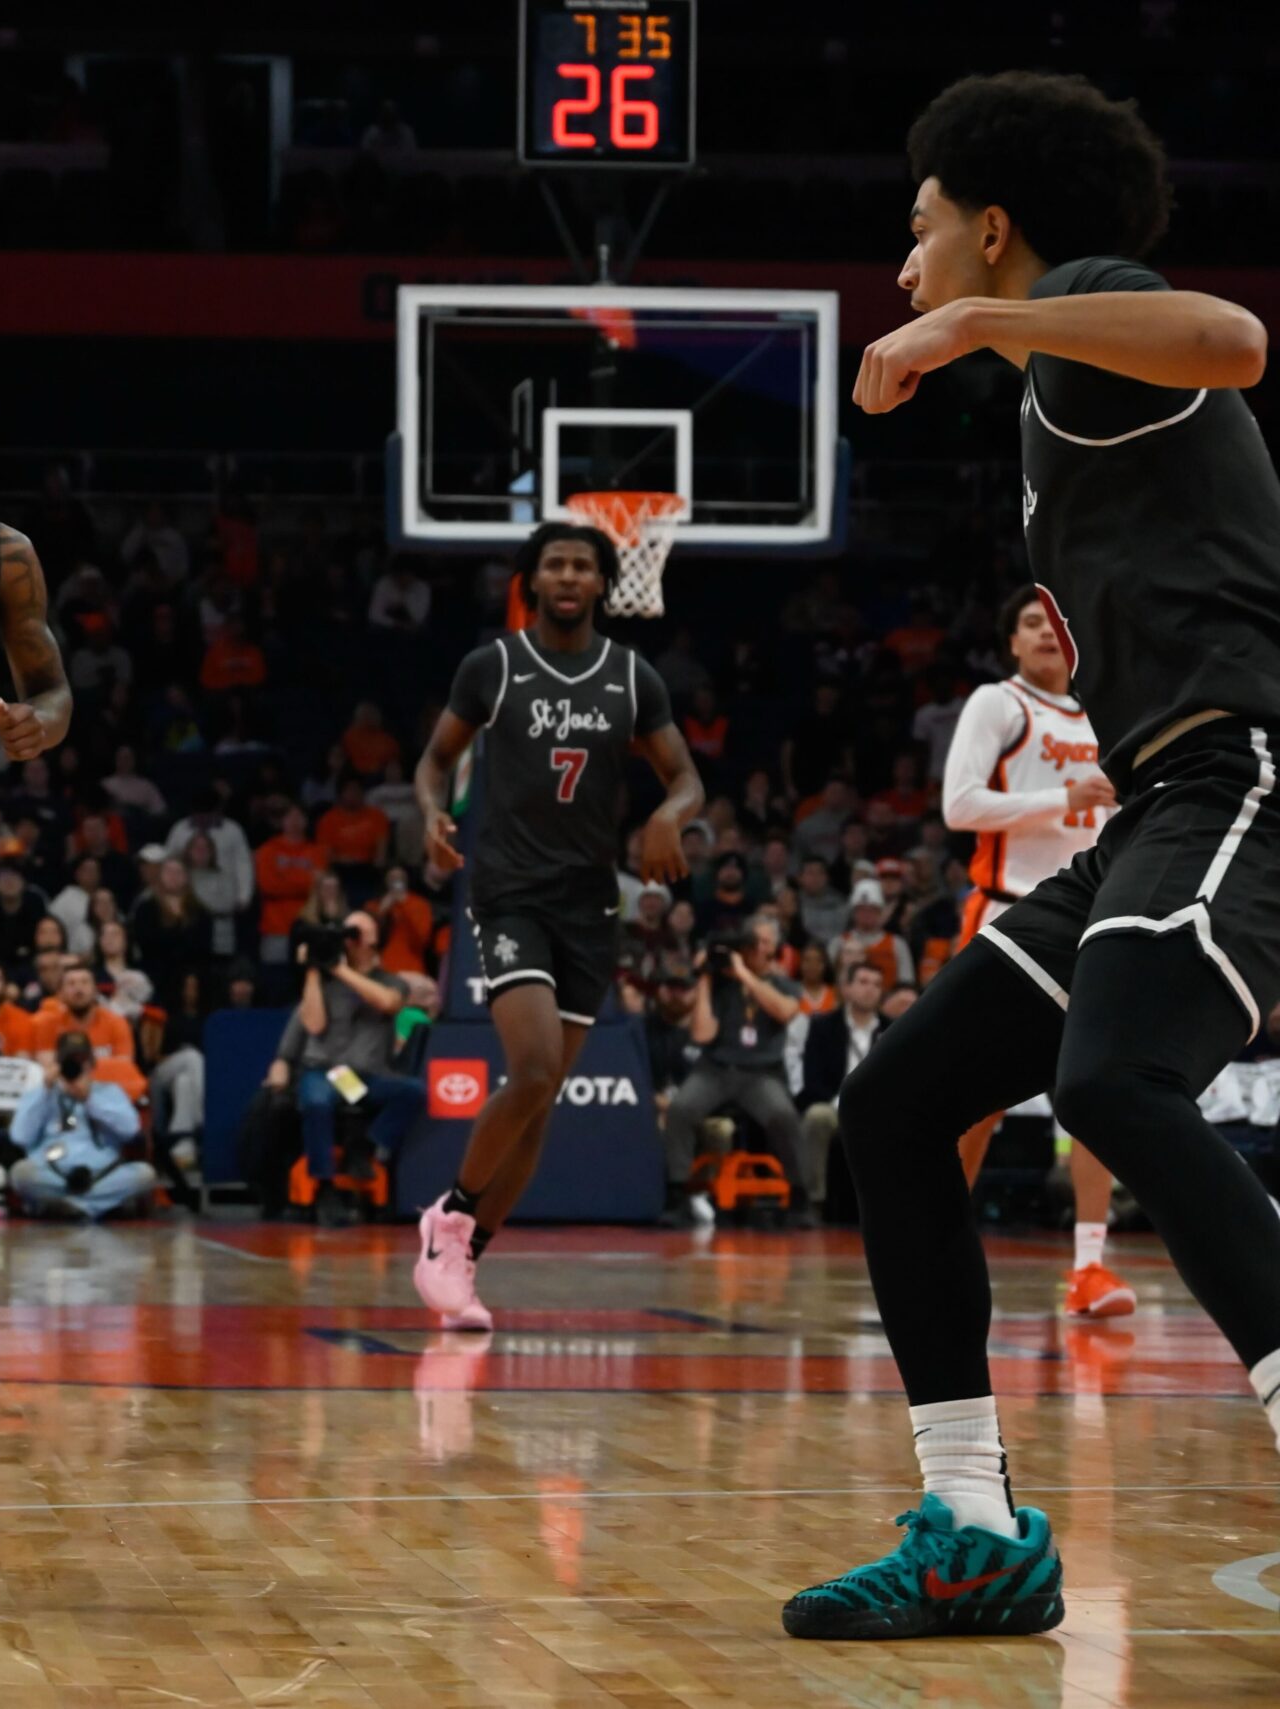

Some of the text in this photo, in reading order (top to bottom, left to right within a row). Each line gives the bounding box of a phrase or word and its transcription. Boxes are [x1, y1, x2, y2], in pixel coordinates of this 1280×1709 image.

[573, 14, 671, 59] 7 35
[552, 63, 659, 148] 26
[550, 747, 589, 803] 7
